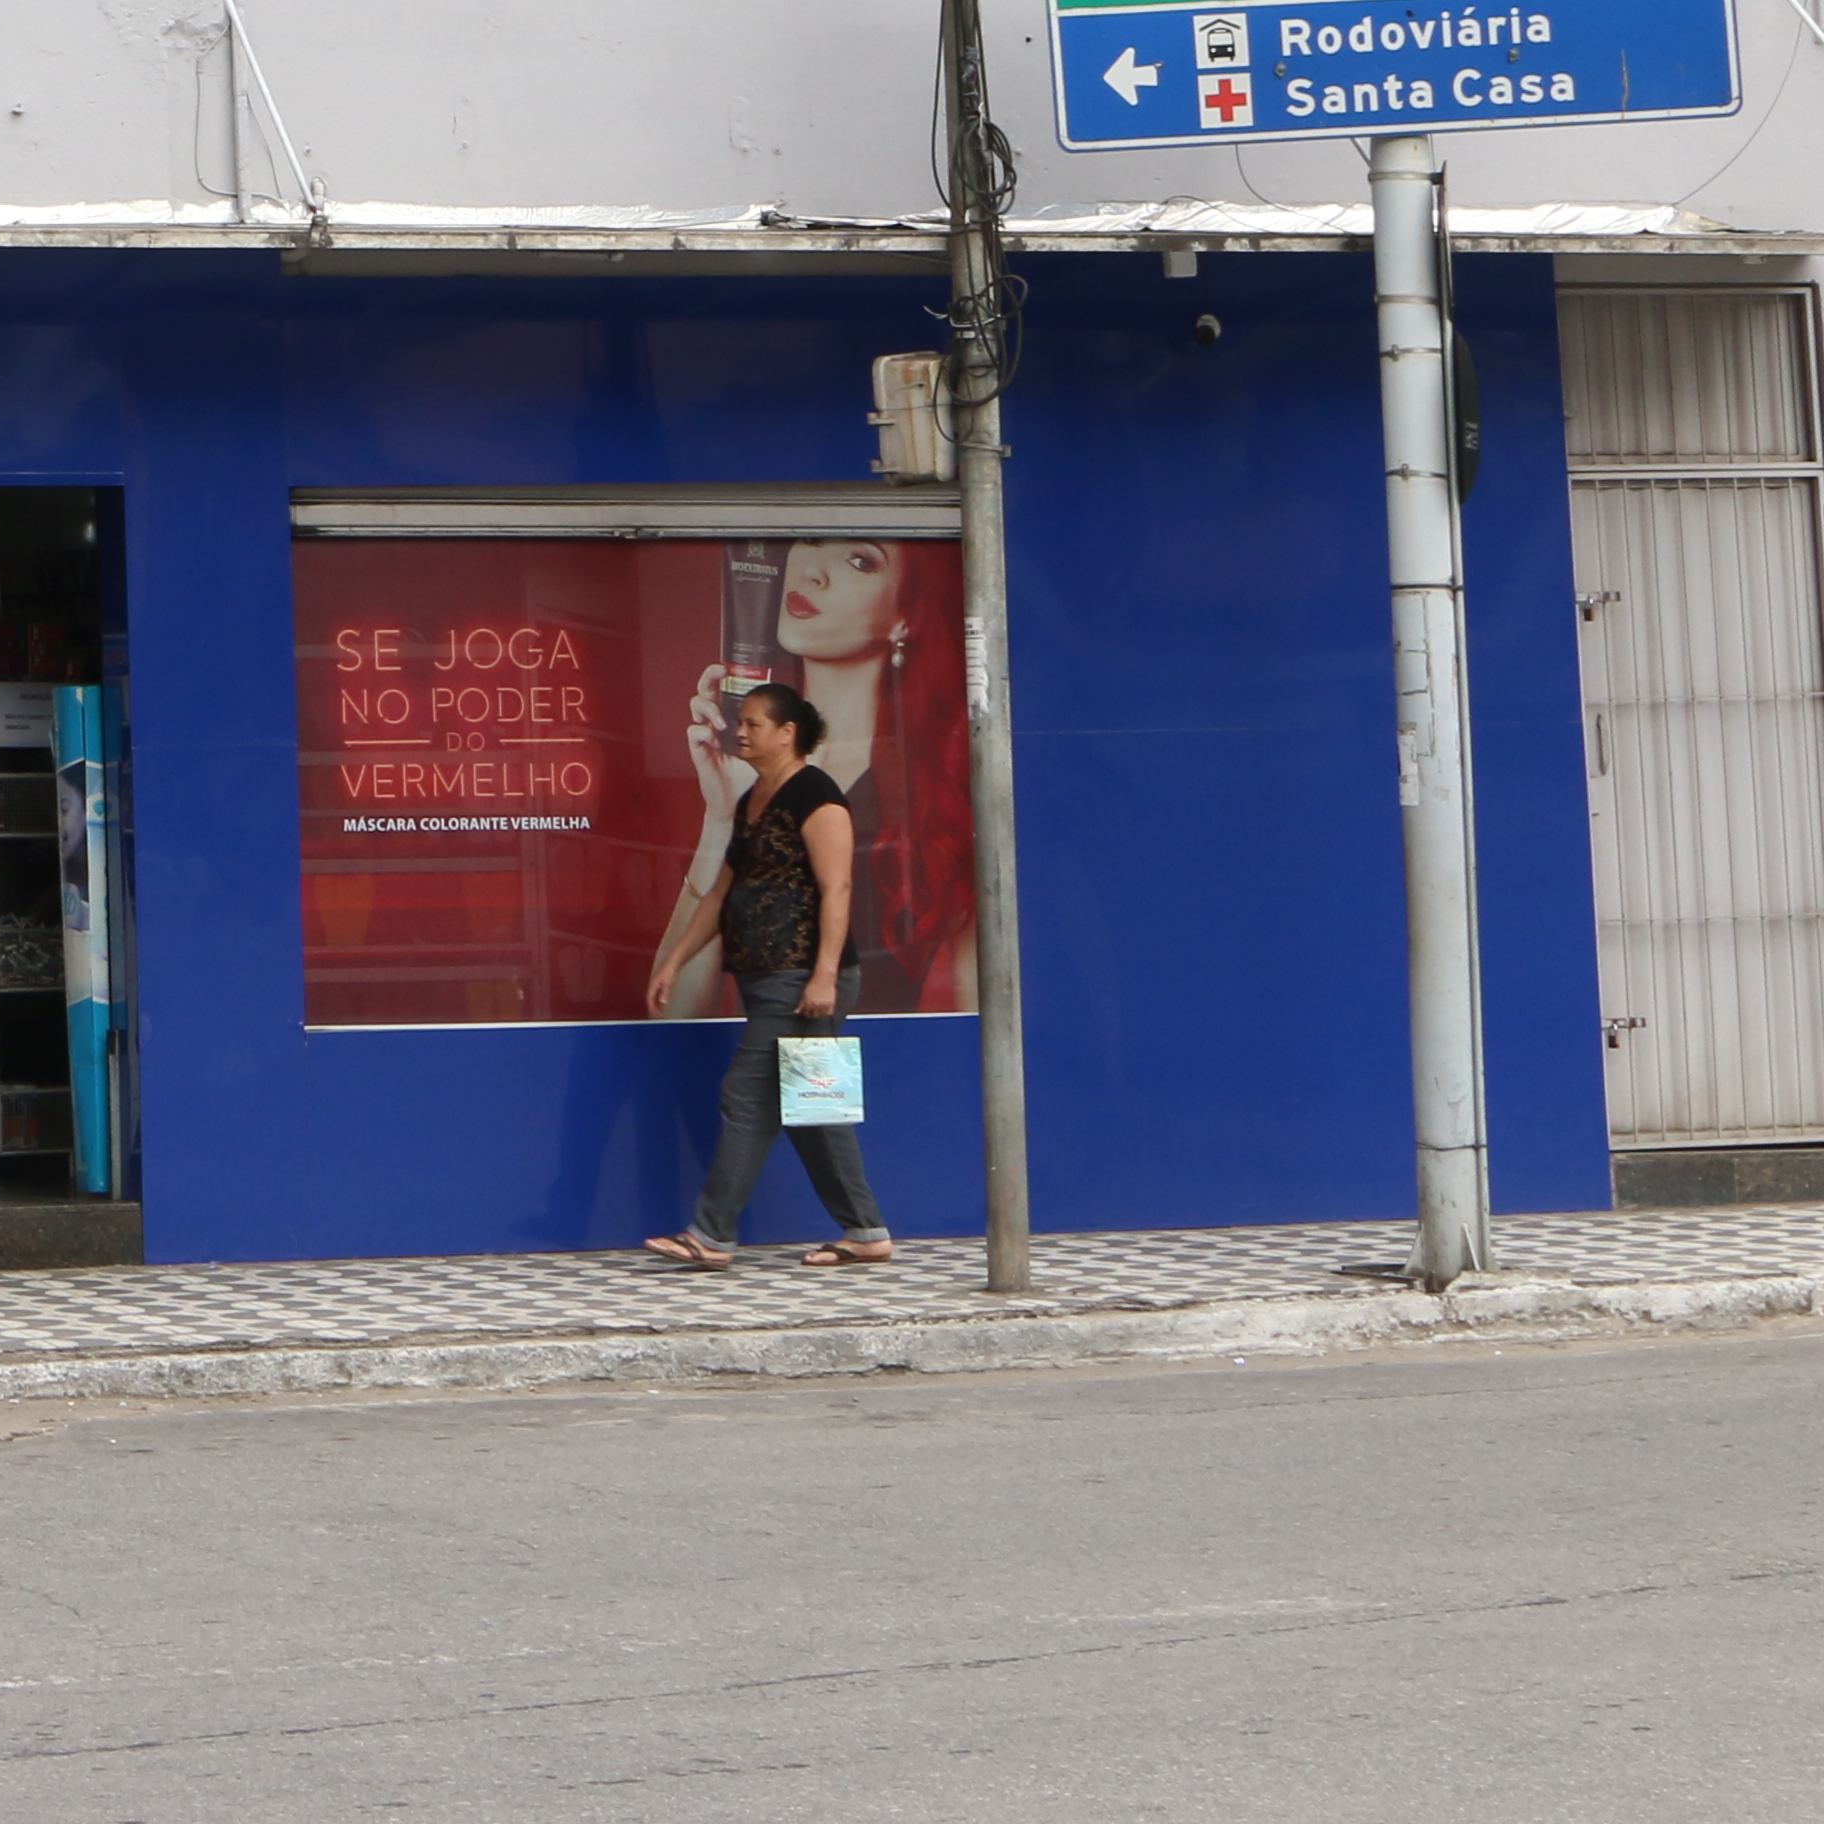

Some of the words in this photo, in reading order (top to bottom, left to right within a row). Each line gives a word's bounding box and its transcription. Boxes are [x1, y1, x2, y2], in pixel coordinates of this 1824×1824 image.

[1280, 6, 1552, 57] Rodoviária
[1285, 72, 1435, 117] Santa
[1452, 64, 1576, 107] Casa
[337, 629, 402, 671] SE
[434, 628, 580, 670] JOGA
[340, 688, 410, 724] NO
[432, 686, 587, 723] PODER
[446, 731, 486, 752] DO
[340, 762, 592, 798] VERMELHO
[343, 816, 417, 833] MÁSCARA
[419, 817, 508, 831] COLORANTE
[511, 816, 591, 830] VERMELHA
